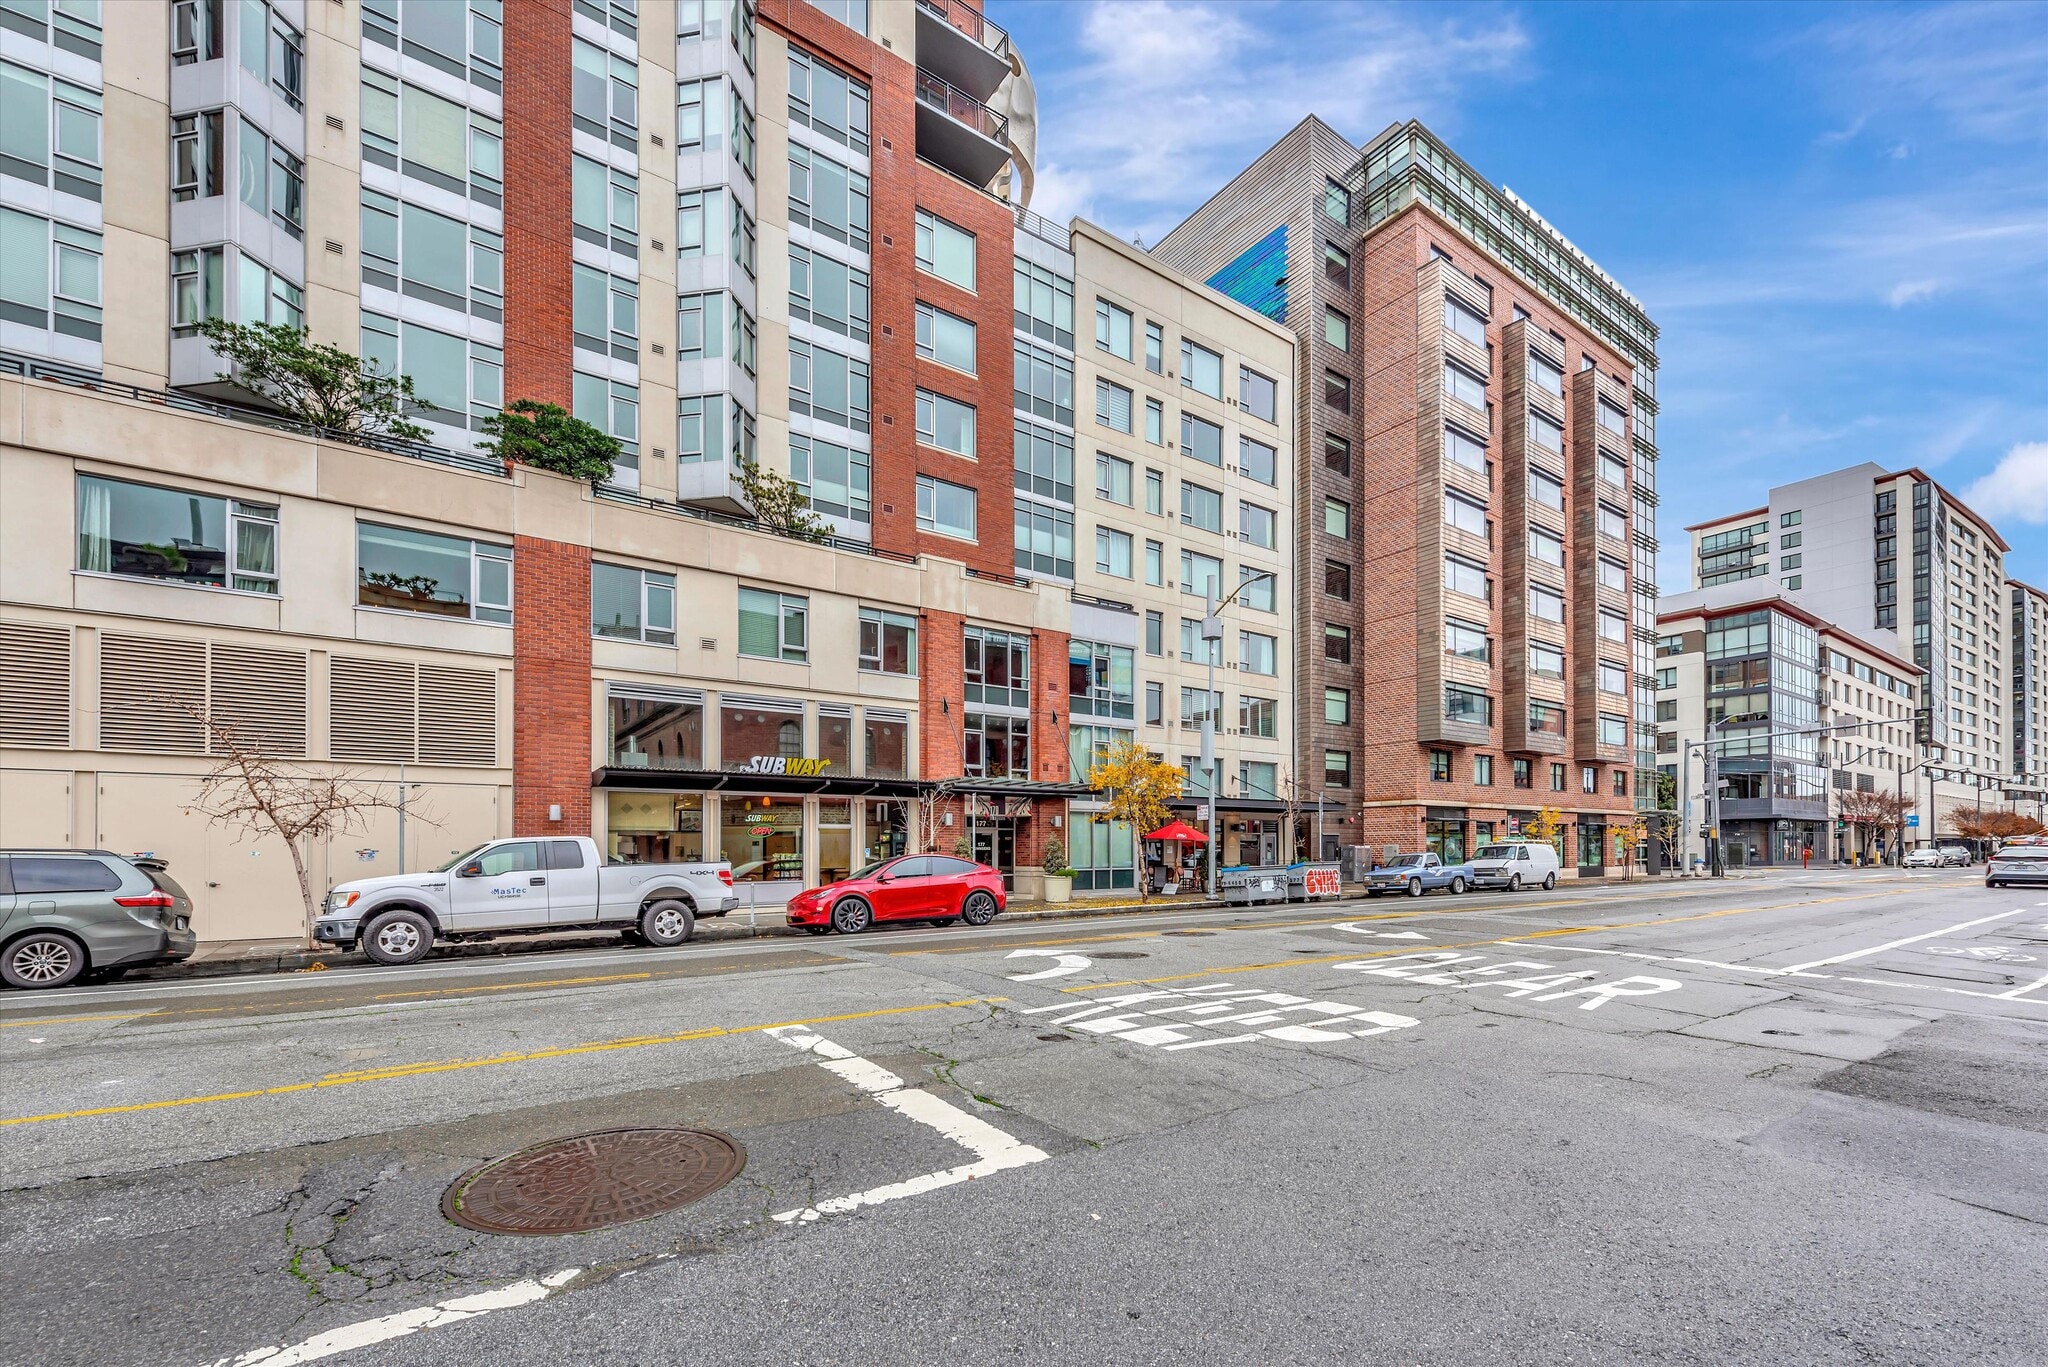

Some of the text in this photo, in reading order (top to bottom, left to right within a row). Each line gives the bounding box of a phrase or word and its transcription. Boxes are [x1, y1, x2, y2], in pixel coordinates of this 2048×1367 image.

[740, 756, 832, 776] SUBWAY
[745, 814, 779, 822] SUBWAY
[750, 827, 774, 835] OPEN
[493, 887, 527, 895] MasTec
[1332, 952, 1683, 1011] CLEAR
[1021, 983, 1422, 1051] KEEP
